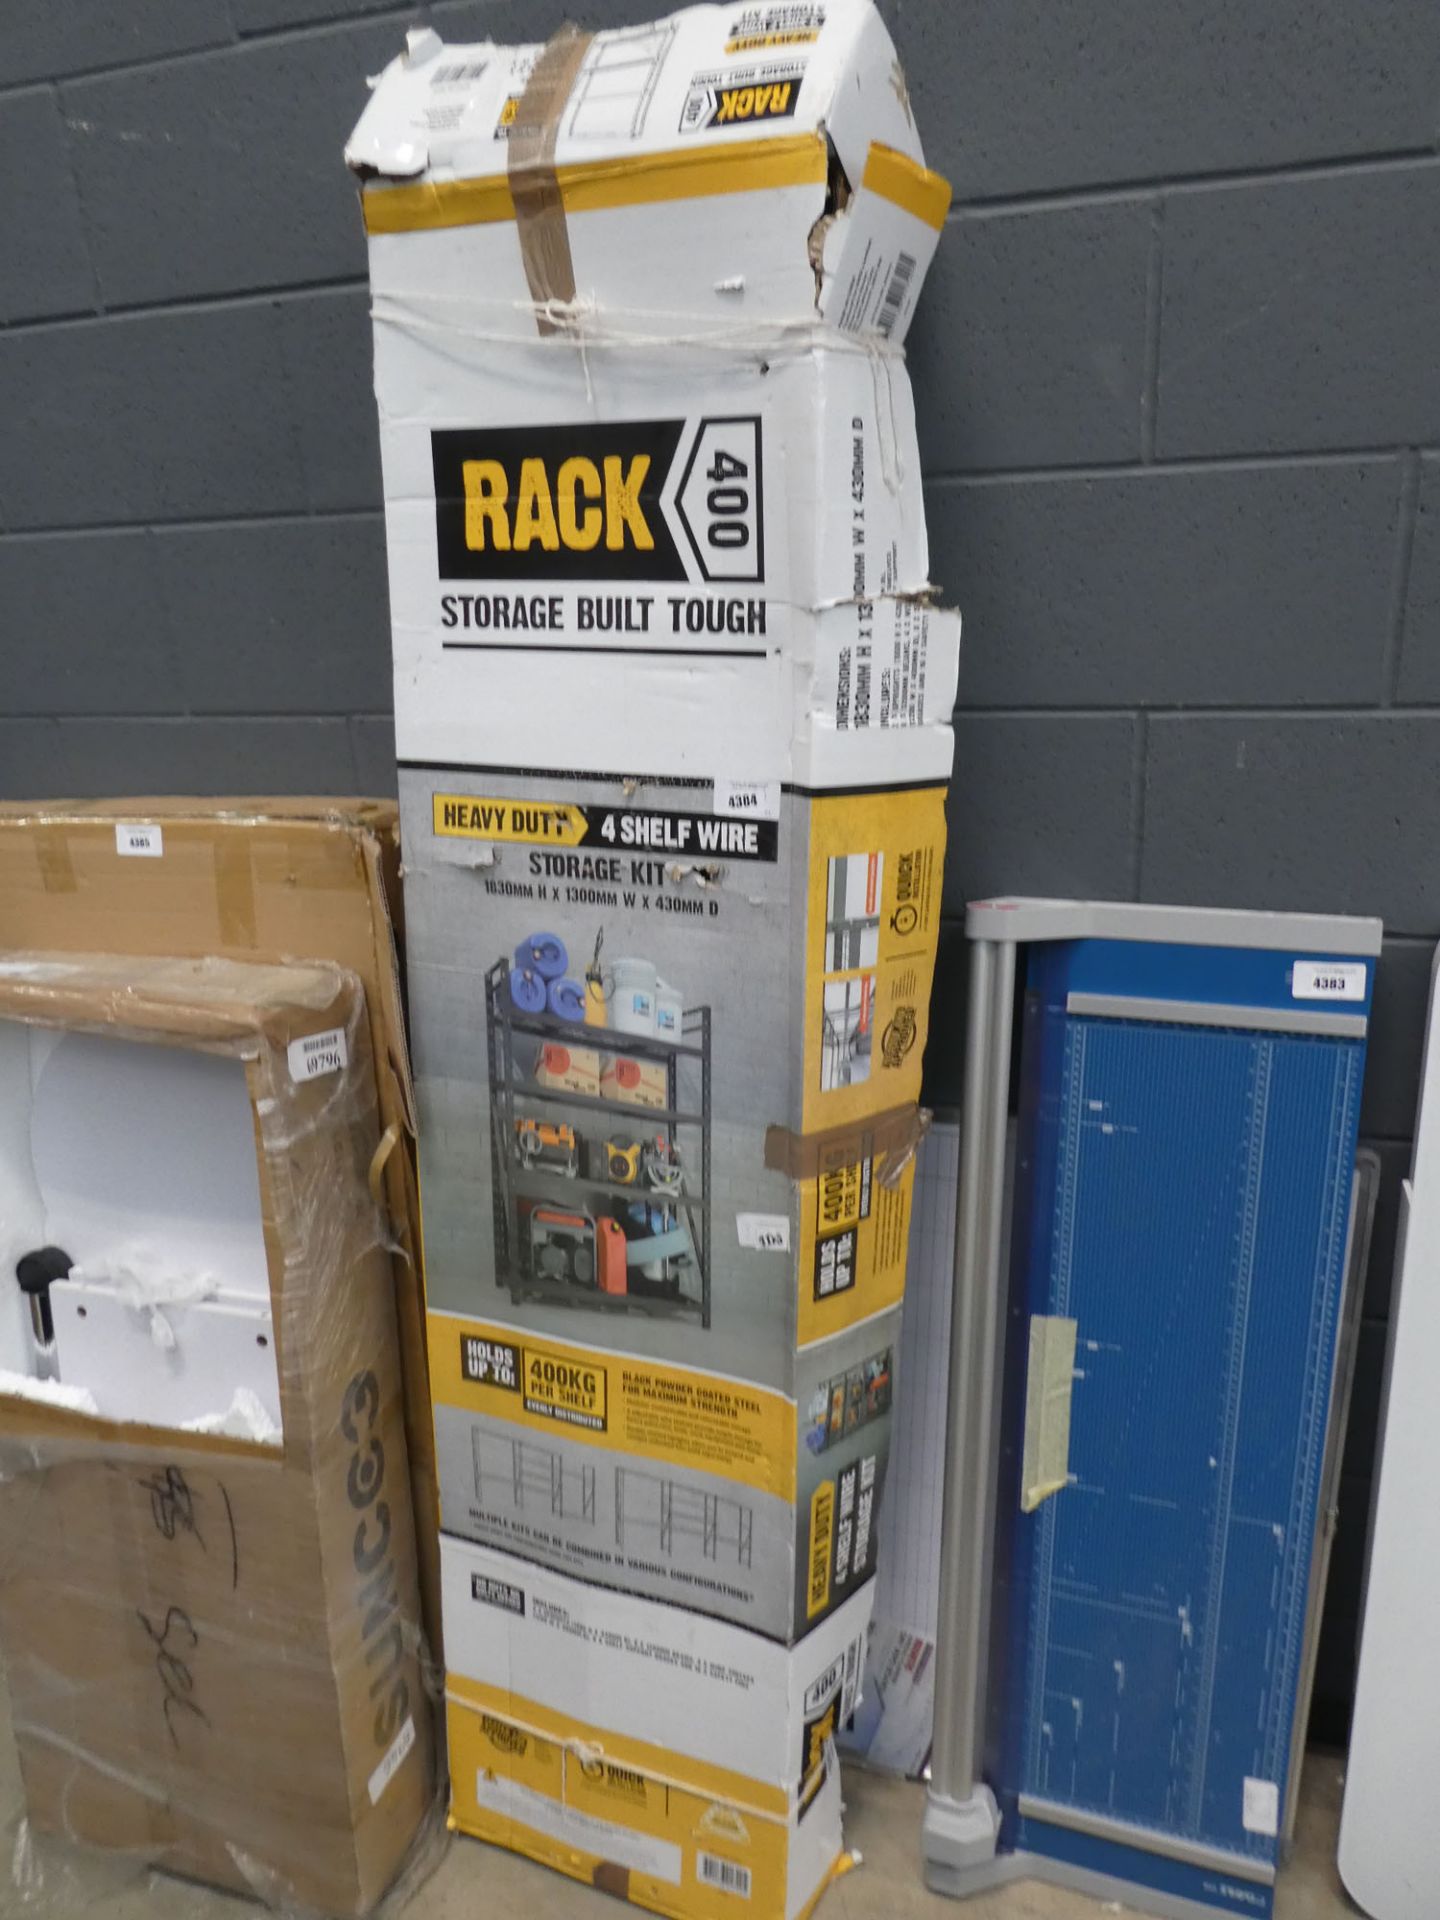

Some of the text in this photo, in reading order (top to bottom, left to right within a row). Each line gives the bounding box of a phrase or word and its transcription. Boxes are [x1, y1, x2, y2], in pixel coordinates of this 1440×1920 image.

[716, 82, 791, 123] RACK
[851, 416, 864, 431] D
[851, 438, 865, 503] 430MM
[462, 454, 655, 551] RACK
[706, 449, 750, 549] 400
[852, 527, 865, 546] W
[441, 594, 767, 636] STORAGE BUILT TOUGH
[444, 803, 568, 837] HEAVY DUTY
[601, 813, 759, 854] 4 SHELF WIRE
[529, 851, 667, 887] STORAGE KIT
[896, 852, 913, 901] QUICK
[485, 879, 534, 899] 1830MM
[538, 885, 547, 900] H
[565, 888, 618, 908] 1300MM
[622, 892, 636, 909] W
[655, 894, 704, 916] 430MM
[709, 900, 719, 917] D
[1313, 977, 1346, 990] 4383
[819, 1239, 836, 1296] HOLDS
[835, 1264, 851, 1290] UP
[467, 1338, 513, 1369] HOLDS
[468, 1357, 488, 1379] UP
[530, 1358, 596, 1394] 400KG
[622, 1370, 651, 1386] BLACK
[655, 1375, 693, 1394] POWDER
[735, 1395, 762, 1415] STEEL
[531, 1380, 595, 1410] PER SHELF
[643, 1386, 688, 1406] MAXIMUM
[840, 1469, 855, 1520] WIRE
[811, 1493, 831, 1603] HEAVY DUTY
[836, 1520, 852, 1572] SHELF
[628, 1558, 667, 1577] VARIOUS
[810, 1668, 837, 1704] 400
